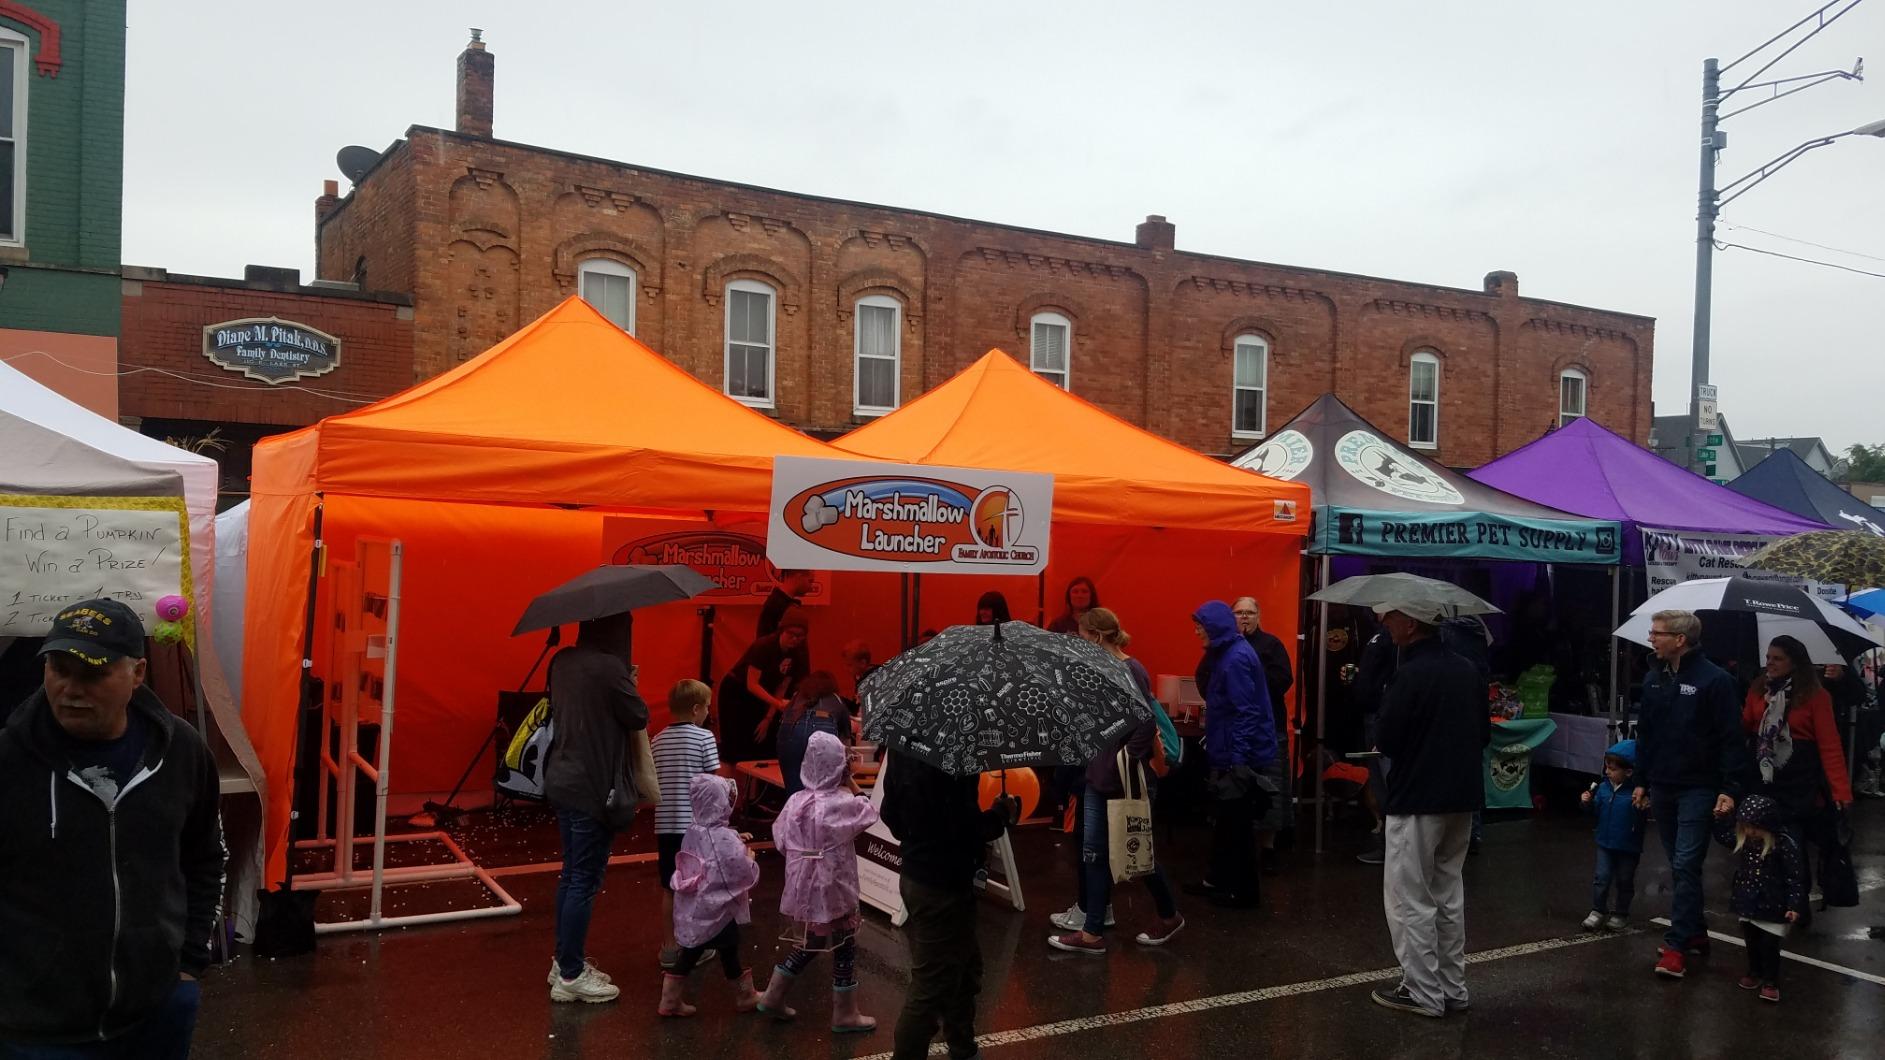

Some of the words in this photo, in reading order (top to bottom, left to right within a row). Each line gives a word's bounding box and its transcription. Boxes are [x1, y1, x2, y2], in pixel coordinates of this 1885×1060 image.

[217, 330, 251, 347] Diane
[253, 325, 269, 342] M.
[236, 346, 266, 361] Family
[270, 348, 310, 364] Dentistry
[1700, 387, 1716, 397] TRUCK
[1703, 405, 1712, 415] NO
[844, 490, 964, 525] Marshmallow
[5, 516, 45, 542] Find
[55, 526, 70, 541] a
[860, 522, 946, 554] Launcher
[1381, 521, 1470, 545] PREMIER
[1476, 522, 1511, 547] PET
[1518, 528, 1587, 551] SUPPLY
[25, 550, 58, 574] Win
[68, 558, 84, 573] a
[663, 543, 760, 567] Marshmallow
[958, 548, 978, 559] FAMILY
[979, 549, 1009, 560] APOSTOLIC
[1010, 549, 1035, 561] CHURCH
[1699, 556, 1716, 568] Cat
[29, 594, 69, 603] TICKET
[4, 611, 20, 626] 2
[59, 608, 112, 626] SEABEES
[867, 841, 903, 866] Welcome
